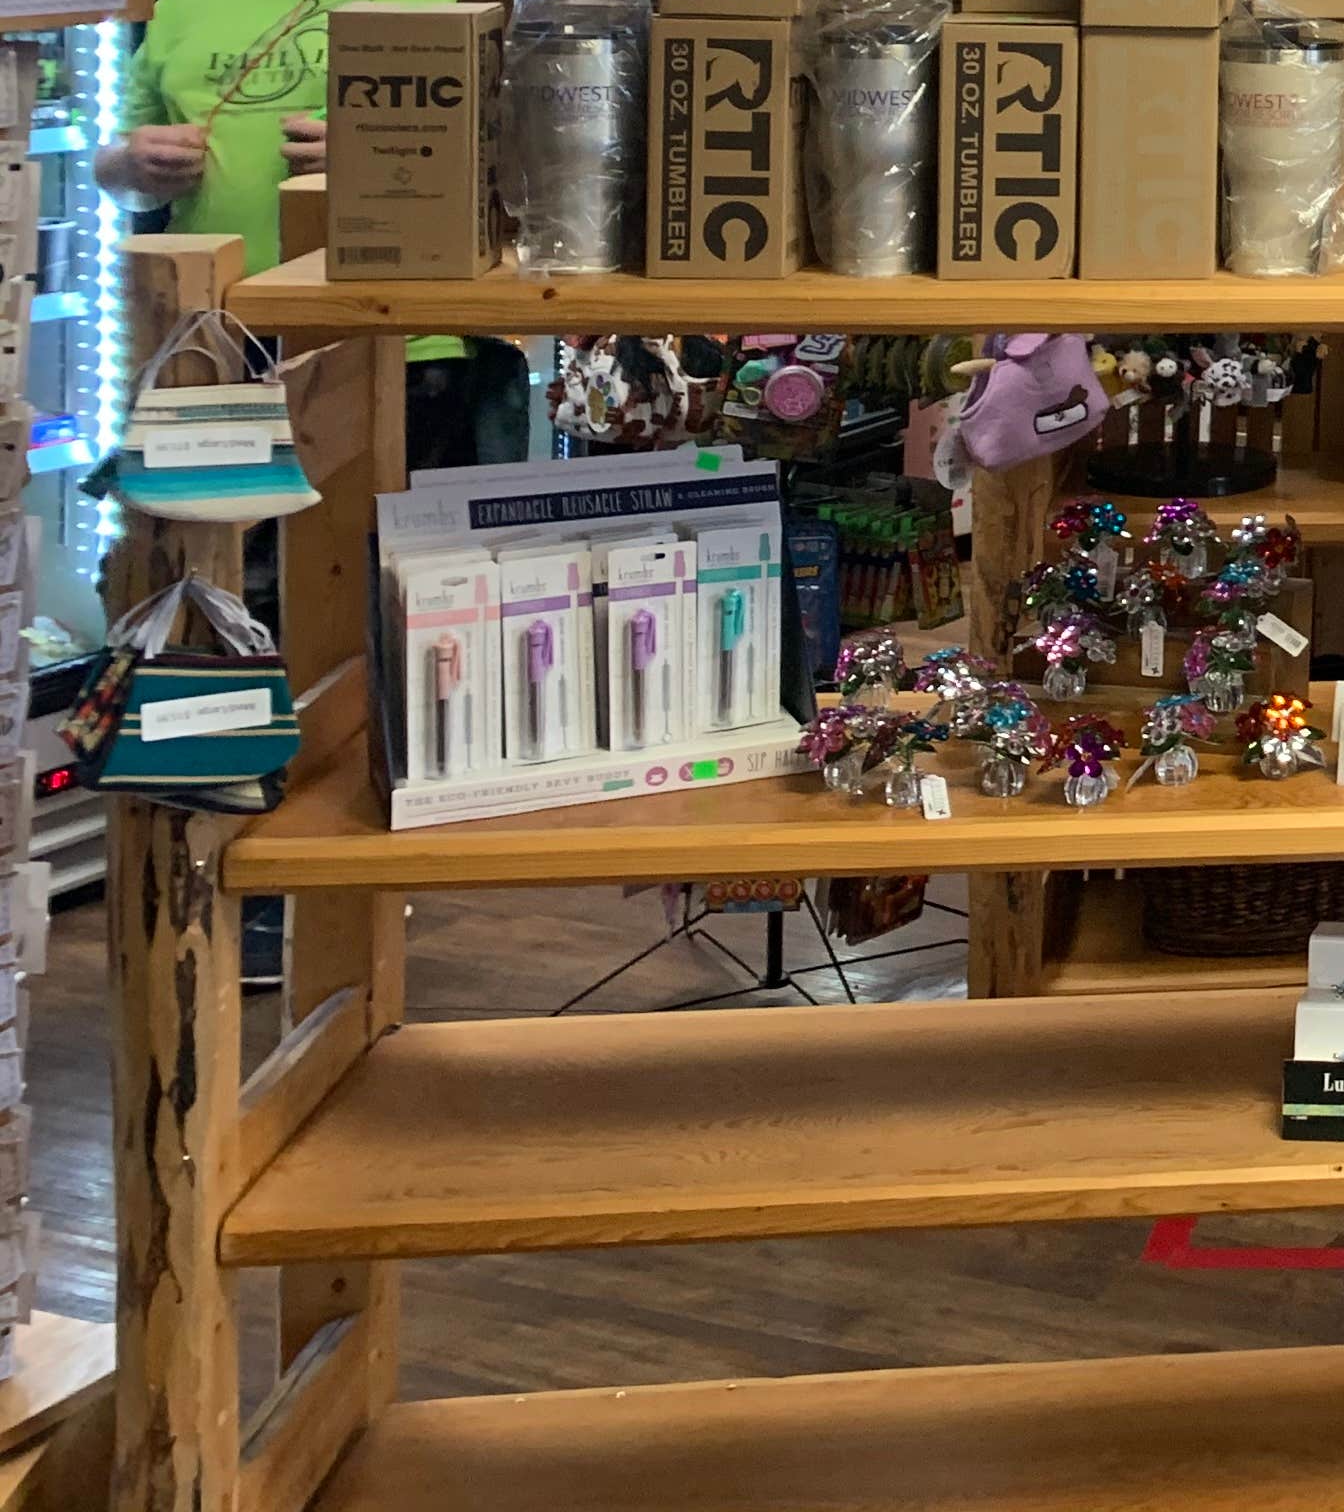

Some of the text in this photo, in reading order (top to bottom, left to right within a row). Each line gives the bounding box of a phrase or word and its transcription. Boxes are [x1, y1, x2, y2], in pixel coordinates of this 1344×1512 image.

[670, 43, 689, 72] 30
[337, 75, 464, 109] RTIC
[703, 38, 773, 262] RTIC
[959, 47, 980, 257] 30 OZ. TUMBLER
[994, 42, 1063, 261] RTIC
[667, 131, 688, 257] TUMBLER
[631, 488, 674, 512] STRAW
[509, 579, 548, 595] krumbs
[617, 565, 655, 581] krumbs
[415, 590, 455, 608] krumbs
[405, 797, 433, 808] THE
[746, 752, 767, 774] SIP
